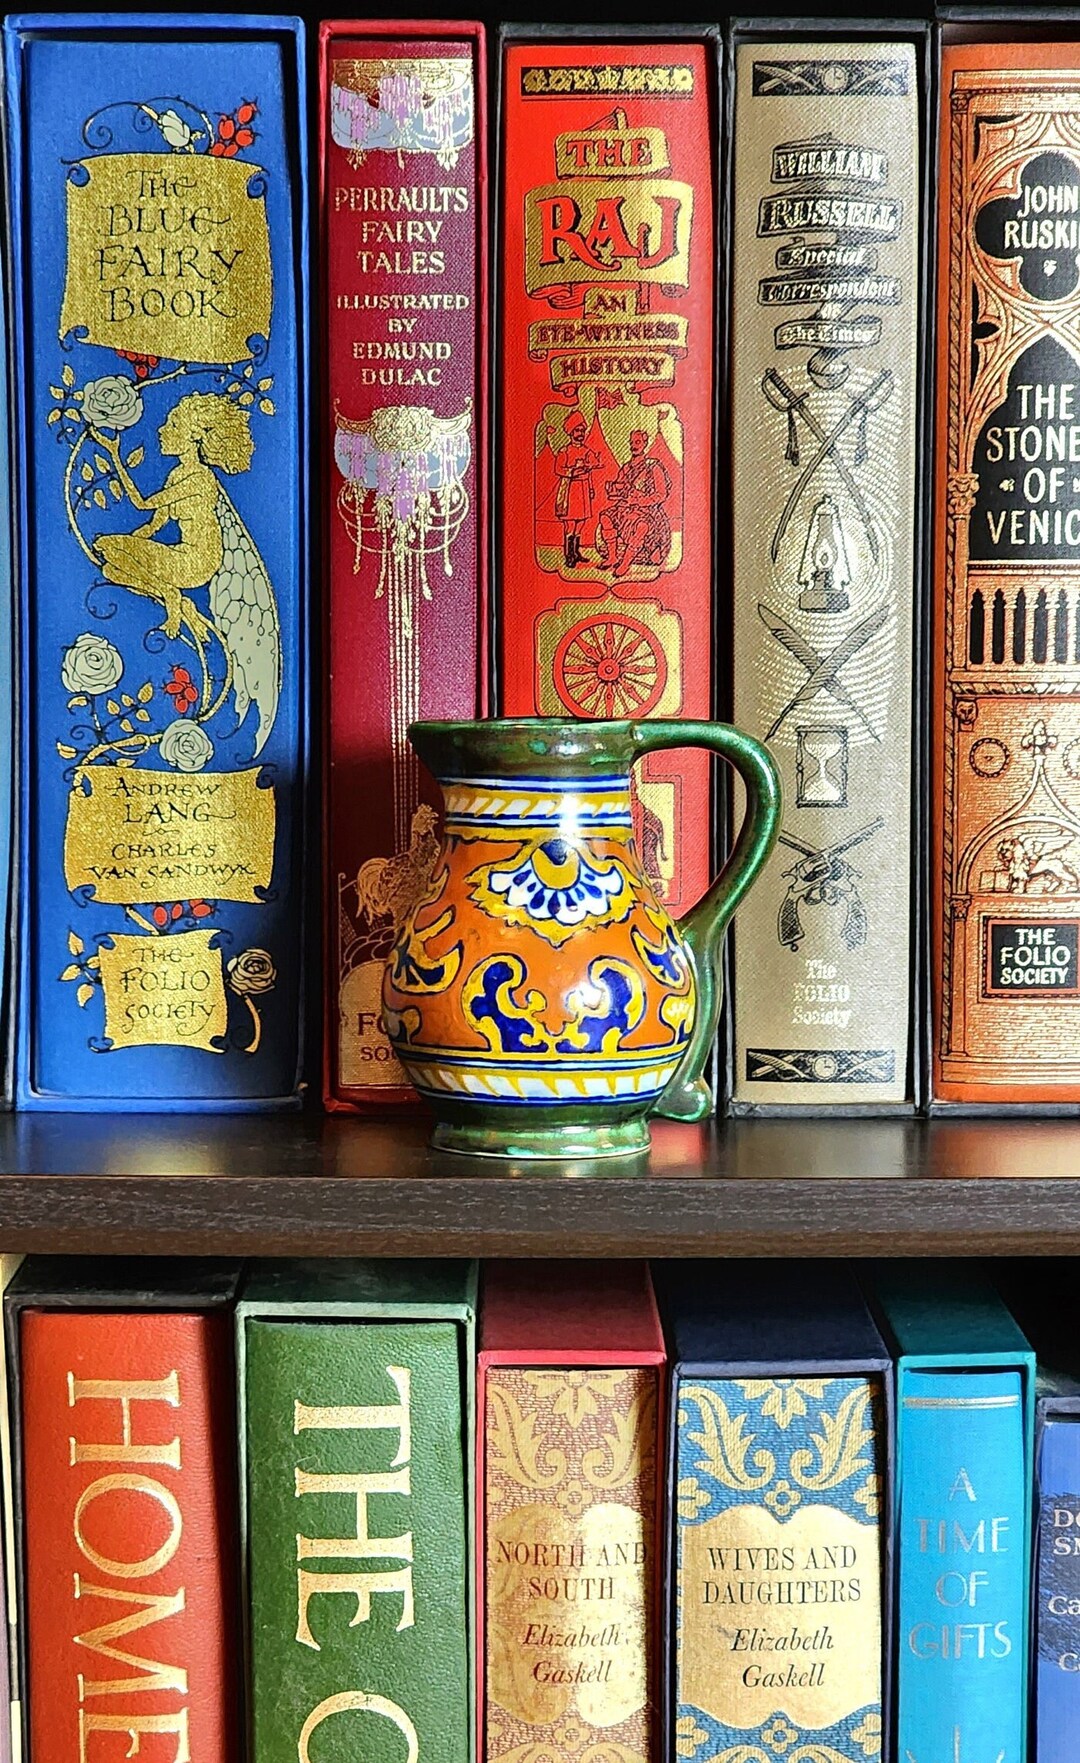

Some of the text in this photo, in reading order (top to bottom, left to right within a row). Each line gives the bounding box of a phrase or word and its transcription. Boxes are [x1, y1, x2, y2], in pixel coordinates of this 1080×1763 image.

[567, 139, 652, 167] THE
[1016, 184, 1079, 218] JOHN
[100, 203, 231, 237] BLUE
[769, 199, 897, 233] RUSSELL
[361, 220, 443, 243] FAIRY
[535, 195, 683, 272] RAJ
[1004, 219, 1080, 250] RUSKI
[92, 244, 244, 286] FAIRY
[357, 250, 446, 275] TALES
[102, 286, 238, 323] BOOK
[336, 294, 470, 311] ILLUSTRATED
[593, 294, 627, 312] AN
[387, 317, 418, 334] BY
[352, 342, 452, 361] EDMUND
[360, 368, 443, 387] DULAC
[560, 356, 667, 376] HISTORY
[1016, 383, 1076, 421] THE
[1023, 467, 1066, 504] OF
[104, 776, 222, 799] ANDREW
[122, 803, 237, 825] LANG
[111, 842, 217, 861] CHARLES
[83, 862, 256, 889] VAN SANDWYK
[1014, 927, 1057, 946] THE
[1000, 946, 1072, 968] FOLIO
[120, 967, 211, 993] FOLIO
[998, 966, 1069, 986] SOCIETY
[121, 999, 216, 1037] SOCIETY
[949, 1466, 978, 1502] A
[293, 1365, 415, 1652] THE
[913, 1516, 1011, 1554] TIME
[497, 1541, 648, 1567] NORTH AND
[707, 1545, 858, 1572] WIVES AND
[529, 1577, 616, 1601] SOUTH
[702, 1578, 862, 1605] DAUGHTERS
[935, 1570, 990, 1607] OF
[522, 1623, 622, 1652] Elizabeth
[730, 1626, 835, 1653] Elizabeth
[908, 1621, 1013, 1659] GIFTS
[532, 1660, 613, 1685] Gaskell
[741, 1664, 826, 1689] Gaskell
